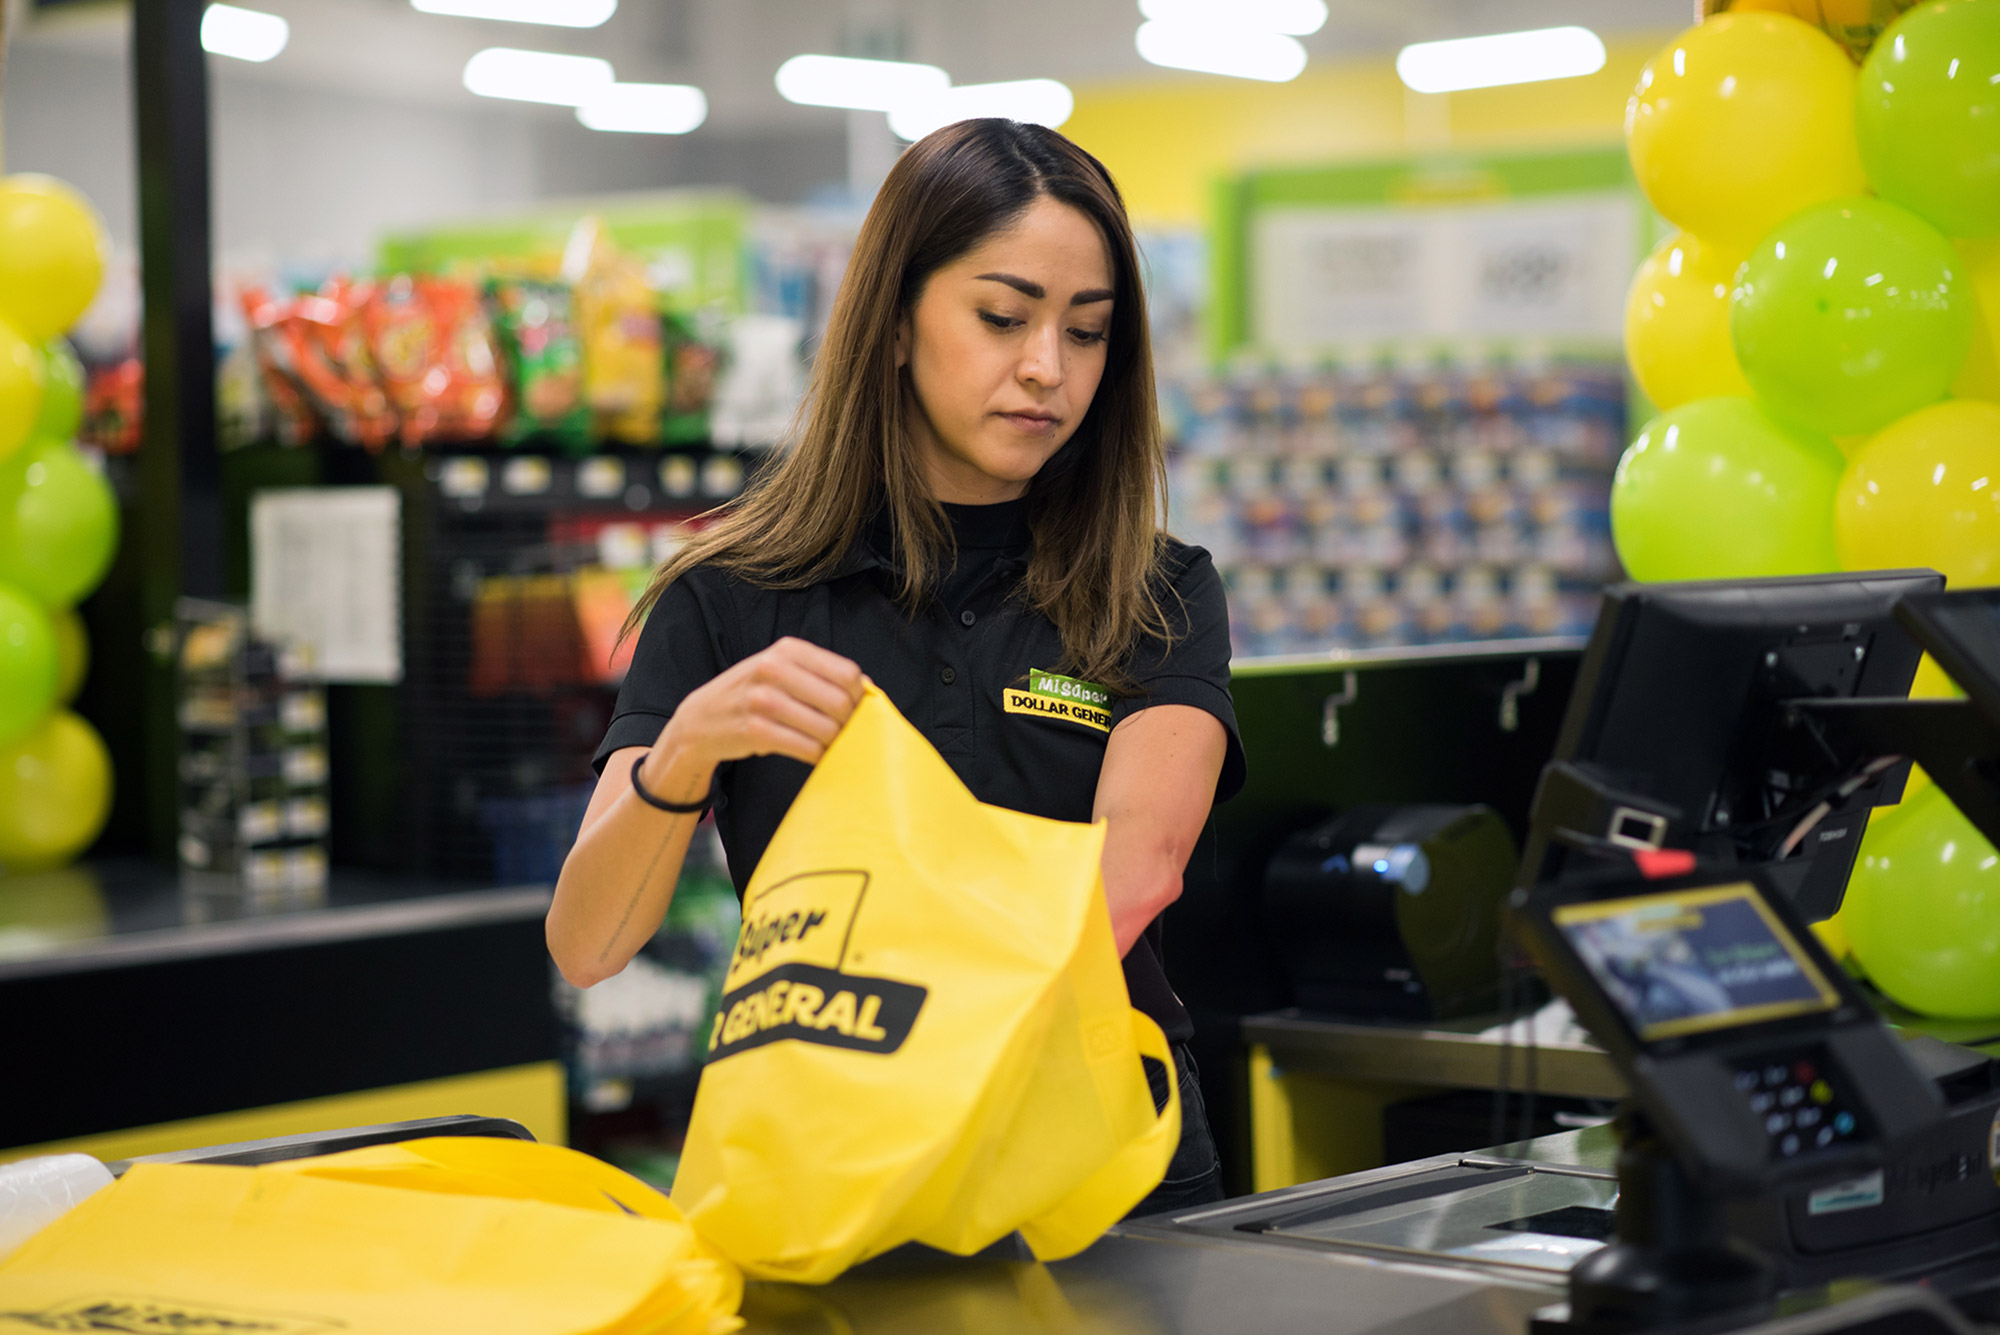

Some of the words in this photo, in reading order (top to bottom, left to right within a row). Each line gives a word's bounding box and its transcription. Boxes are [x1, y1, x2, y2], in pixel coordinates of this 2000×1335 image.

[1011, 695, 1069, 716] DOLLAR
[1072, 706, 1111, 728] GENER
[721, 979, 887, 1046] GENERAL
